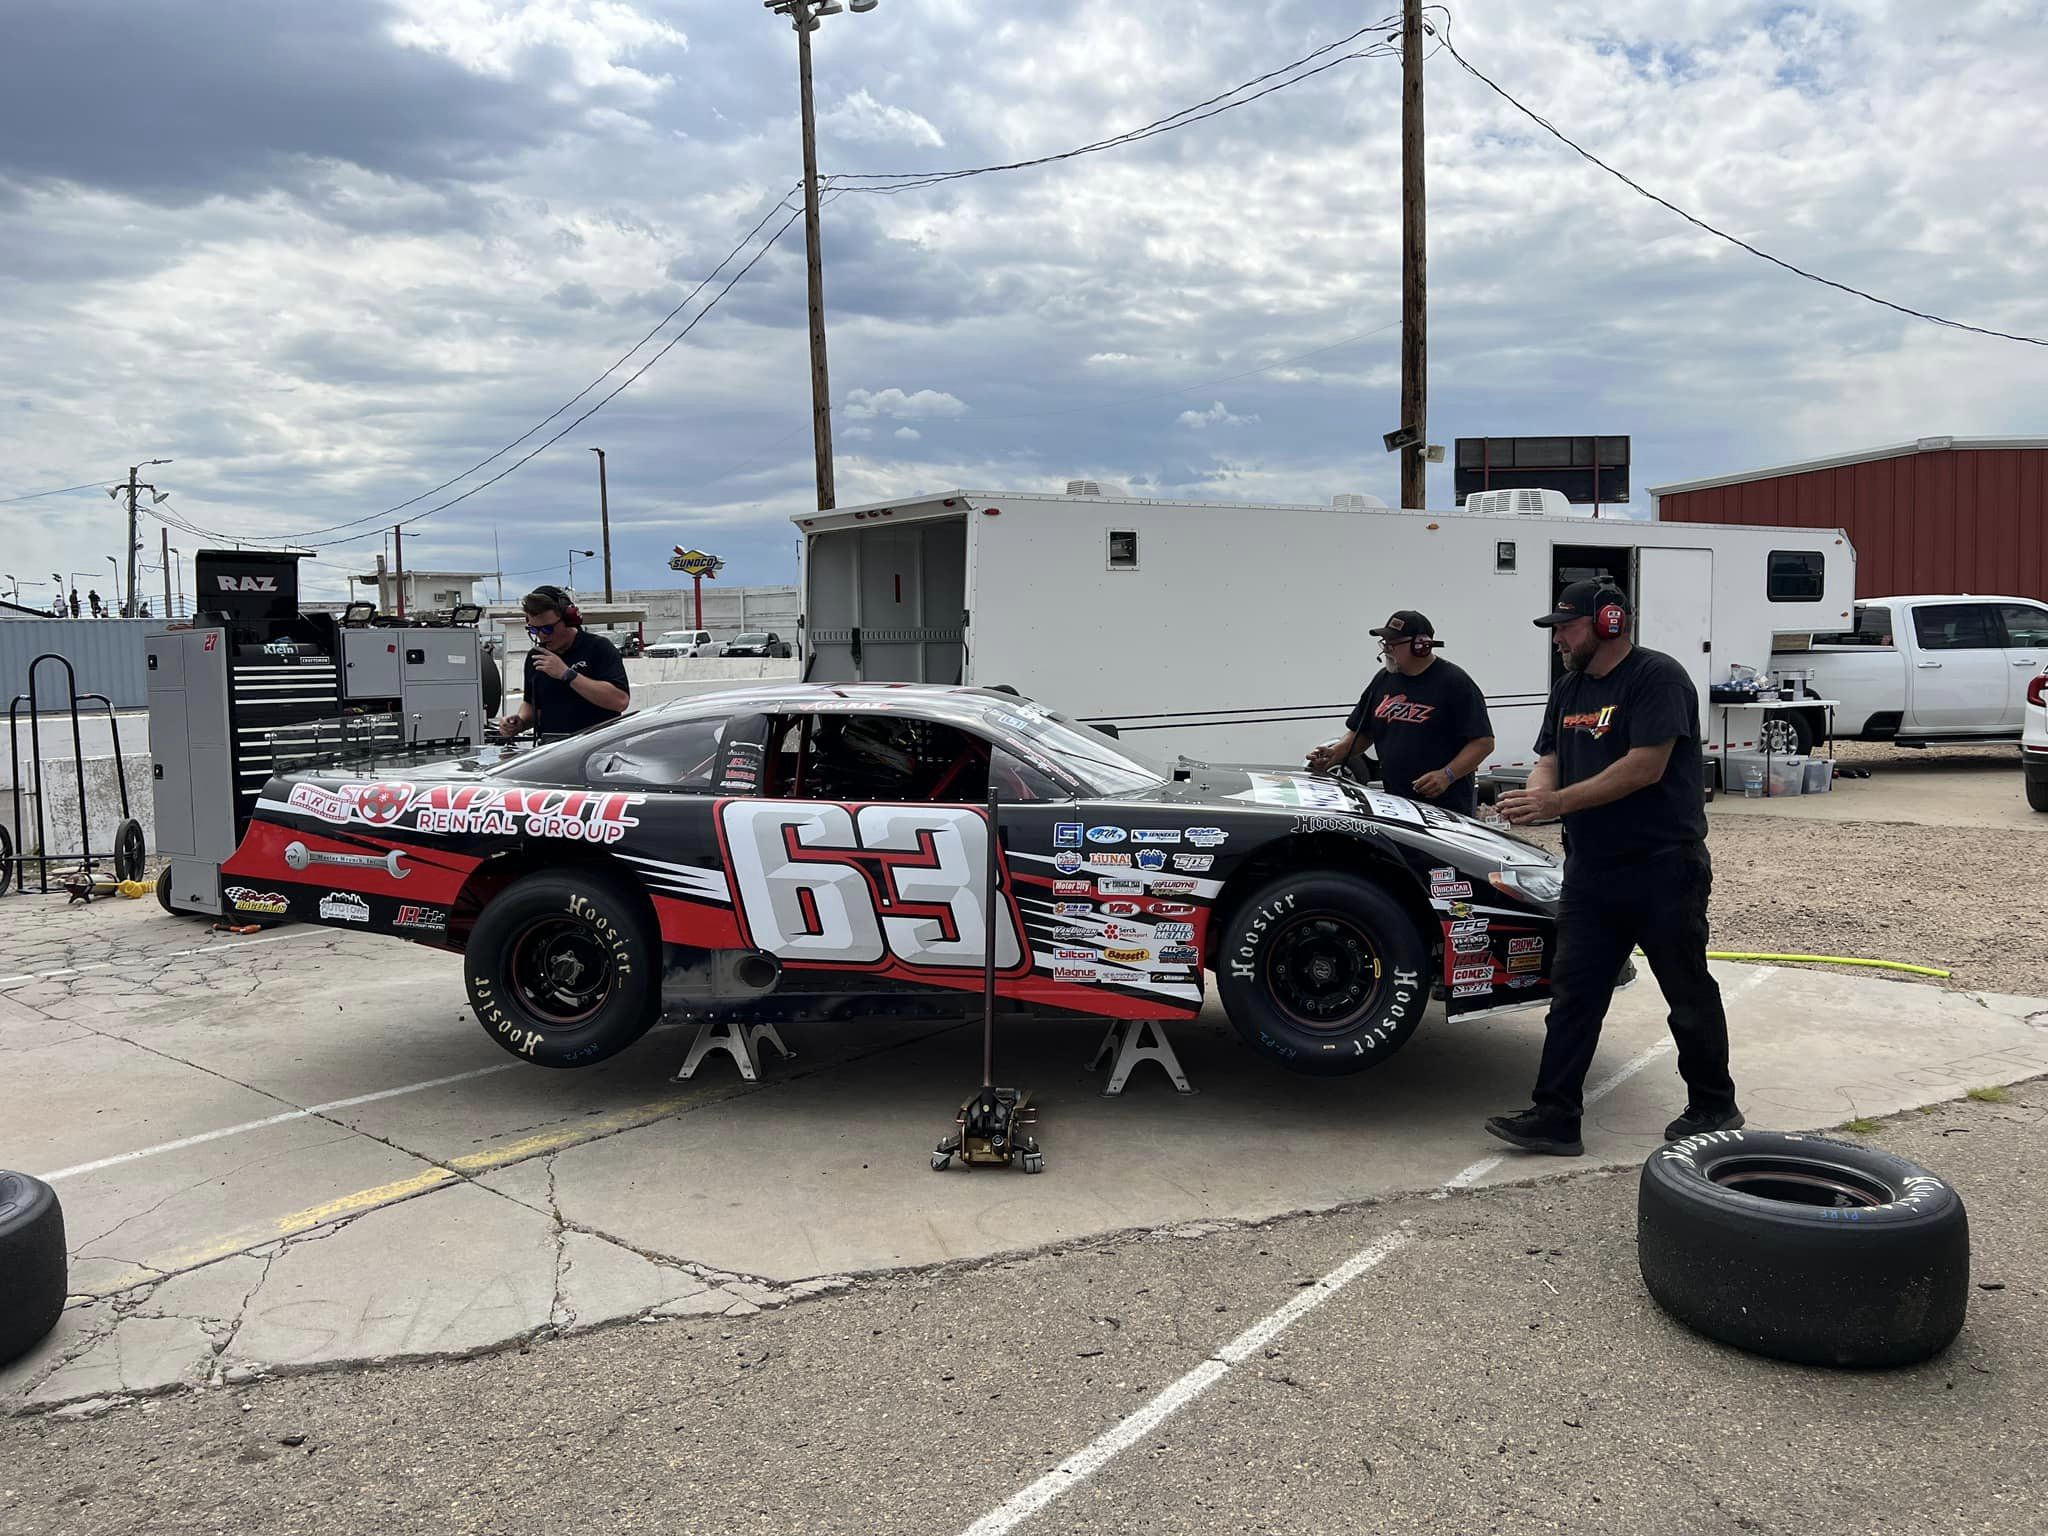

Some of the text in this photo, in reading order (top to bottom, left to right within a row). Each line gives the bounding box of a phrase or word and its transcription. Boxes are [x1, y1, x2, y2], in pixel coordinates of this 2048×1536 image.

[672, 557, 715, 568] SUNOCO
[217, 575, 278, 592] RAZ
[203, 632, 219, 651] 27
[264, 645, 294, 655] Klein
[295, 788, 339, 813] ARG
[410, 785, 646, 827] APACHE
[418, 811, 624, 843] RENTAL GROUP
[1290, 815, 1379, 835] Hoosier
[720, 799, 1024, 971] 63
[1056, 881, 1090, 892] Motor City
[564, 894, 631, 974] Hoosier
[1231, 894, 1295, 983] Hoosier
[1511, 939, 1534, 948] CROW
[1058, 950, 1094, 959] tilton
[1108, 950, 1145, 960] Bassett
[1055, 967, 1096, 978] Magnus
[1455, 969, 1483, 980] COMP
[475, 977, 545, 1056] Hoosier
[1354, 966, 1419, 1056] Hoosier
